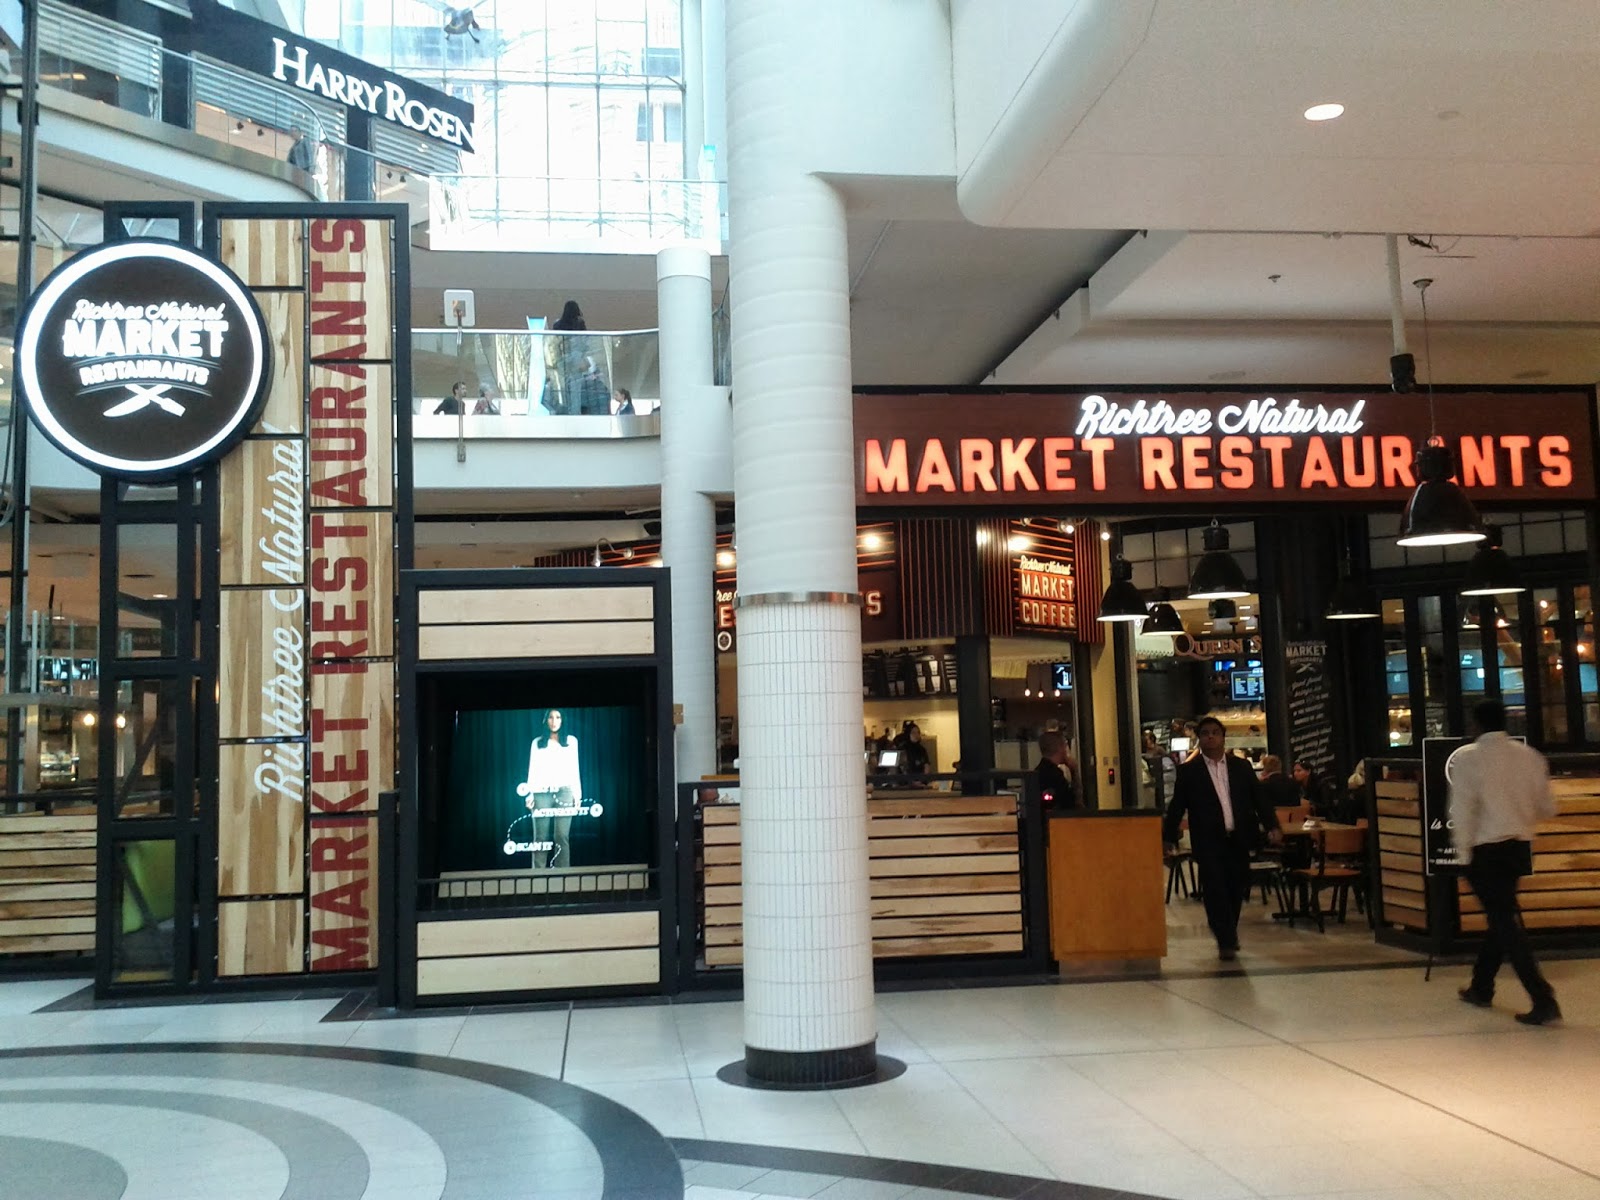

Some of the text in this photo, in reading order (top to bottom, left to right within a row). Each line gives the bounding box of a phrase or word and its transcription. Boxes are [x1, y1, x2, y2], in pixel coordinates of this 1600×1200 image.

[272, 37, 475, 150] HARRY ROSEN
[62, 319, 229, 358] MARKET
[79, 360, 210, 386] RESTAURANTS
[1075, 395, 1366, 440] Richtree Natural
[865, 434, 1573, 492] MARKET RESTAURNTS
[310, 217, 368, 971] MARKET RESTAURANTS
[1021, 573, 1073, 600] MARKET
[1022, 601, 1075, 627] COFFEE
[1285, 645, 1328, 657] MARKET
[254, 625, 304, 802] Richtree
